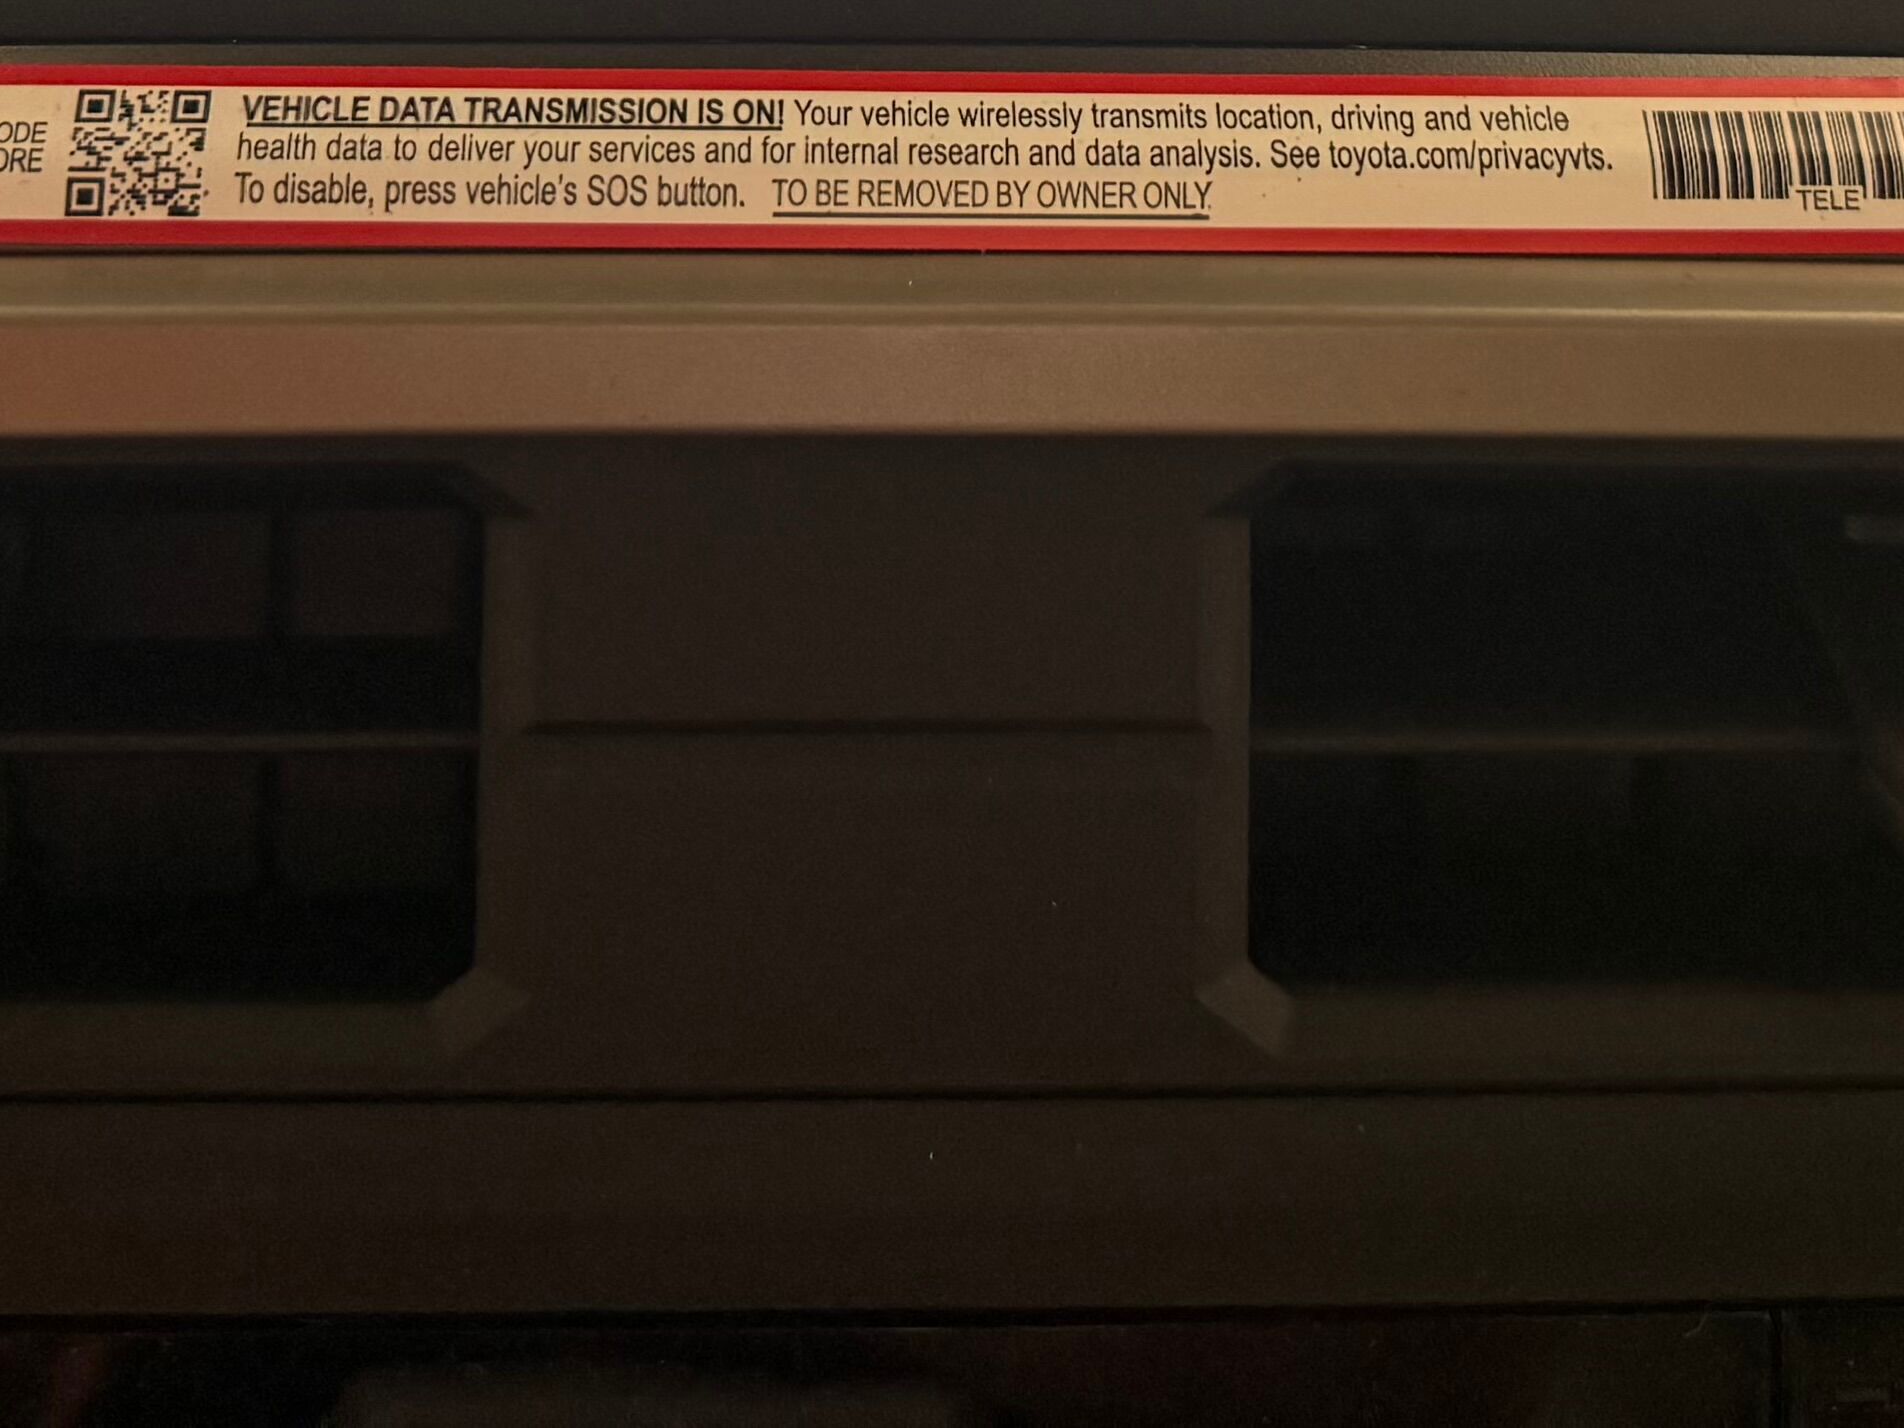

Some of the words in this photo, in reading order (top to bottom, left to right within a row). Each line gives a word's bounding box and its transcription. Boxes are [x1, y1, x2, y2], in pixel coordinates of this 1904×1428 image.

[243, 95, 370, 122] VEHICLE
[379, 96, 455, 123] DATA
[464, 96, 689, 124] TRANSMISSION
[698, 97, 724, 125] IS
[733, 99, 785, 126] ON!
[794, 99, 853, 127] Your
[861, 100, 950, 127] vehicle
[958, 101, 1083, 135] wirelessly
[1092, 102, 1207, 129] transmits
[1216, 103, 1323, 135] location,
[1331, 104, 1416, 137] driving
[1424, 104, 1473, 132] and
[1480, 105, 1570, 132] vehicle
[236, 132, 316, 161] health
[326, 133, 383, 161] data
[394, 135, 417, 162] to
[428, 133, 515, 162] deliver
[523, 140, 580, 169] your
[588, 136, 695, 163] services
[704, 136, 752, 164] and
[762, 136, 796, 164] for
[804, 137, 898, 165] internal
[908, 138, 1020, 166] research
[1029, 139, 1076, 166] and
[1086, 139, 1141, 167] data
[1149, 140, 1261, 174] analysis.
[1270, 140, 1321, 169] See
[1329, 141, 1614, 177] toyota.com/privacyvts.
[234, 172, 264, 204] To
[273, 173, 374, 209] disable,
[384, 181, 456, 213] press
[465, 174, 577, 205] vehicle's
[587, 175, 647, 206] SOS
[657, 175, 745, 207] button.
[772, 178, 807, 206] TO
[816, 179, 849, 206] BE
[857, 179, 989, 208] REMOVED
[997, 180, 1031, 207] BY
[1036, 180, 1138, 208] OWNER
[1797, 188, 1861, 211] TELE
